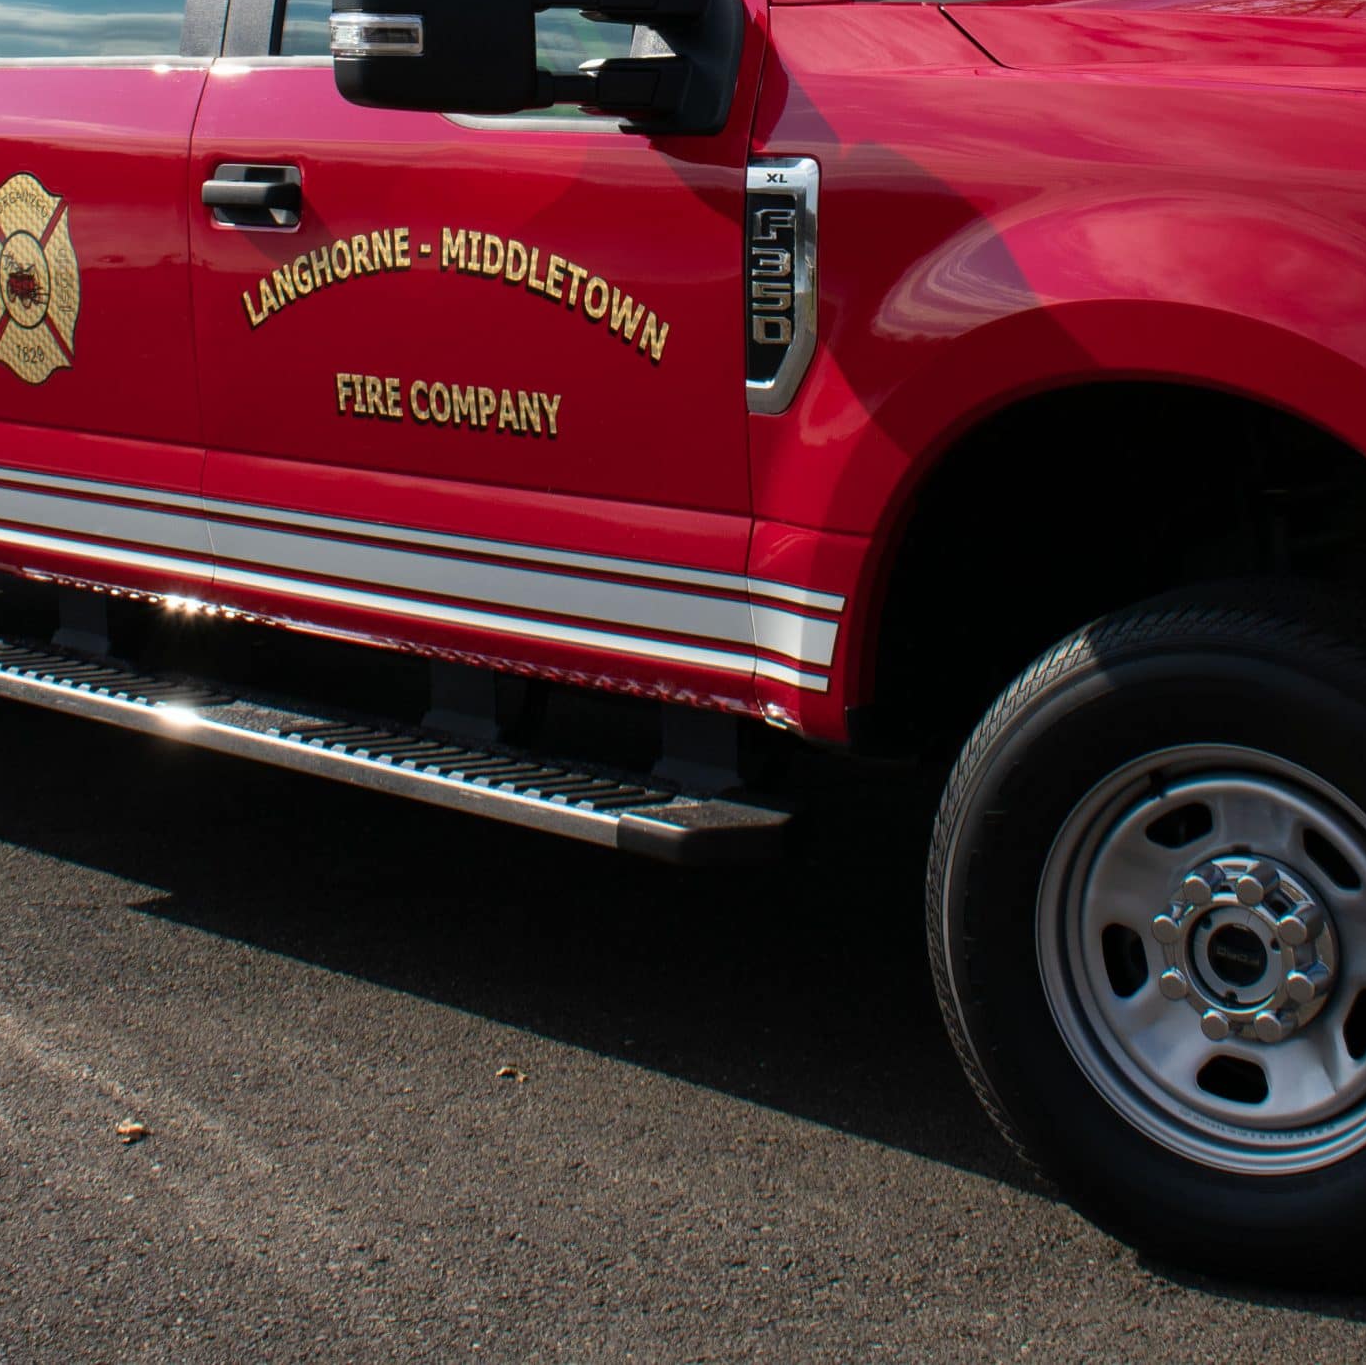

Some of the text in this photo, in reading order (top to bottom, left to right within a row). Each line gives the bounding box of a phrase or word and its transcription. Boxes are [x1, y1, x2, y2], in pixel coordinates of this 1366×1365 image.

[766, 173, 788, 184] XL
[242, 227, 412, 327] LANGHORNE
[441, 228, 670, 361] MIDDLETOWN
[336, 372, 562, 435] FIRE COMPANY
